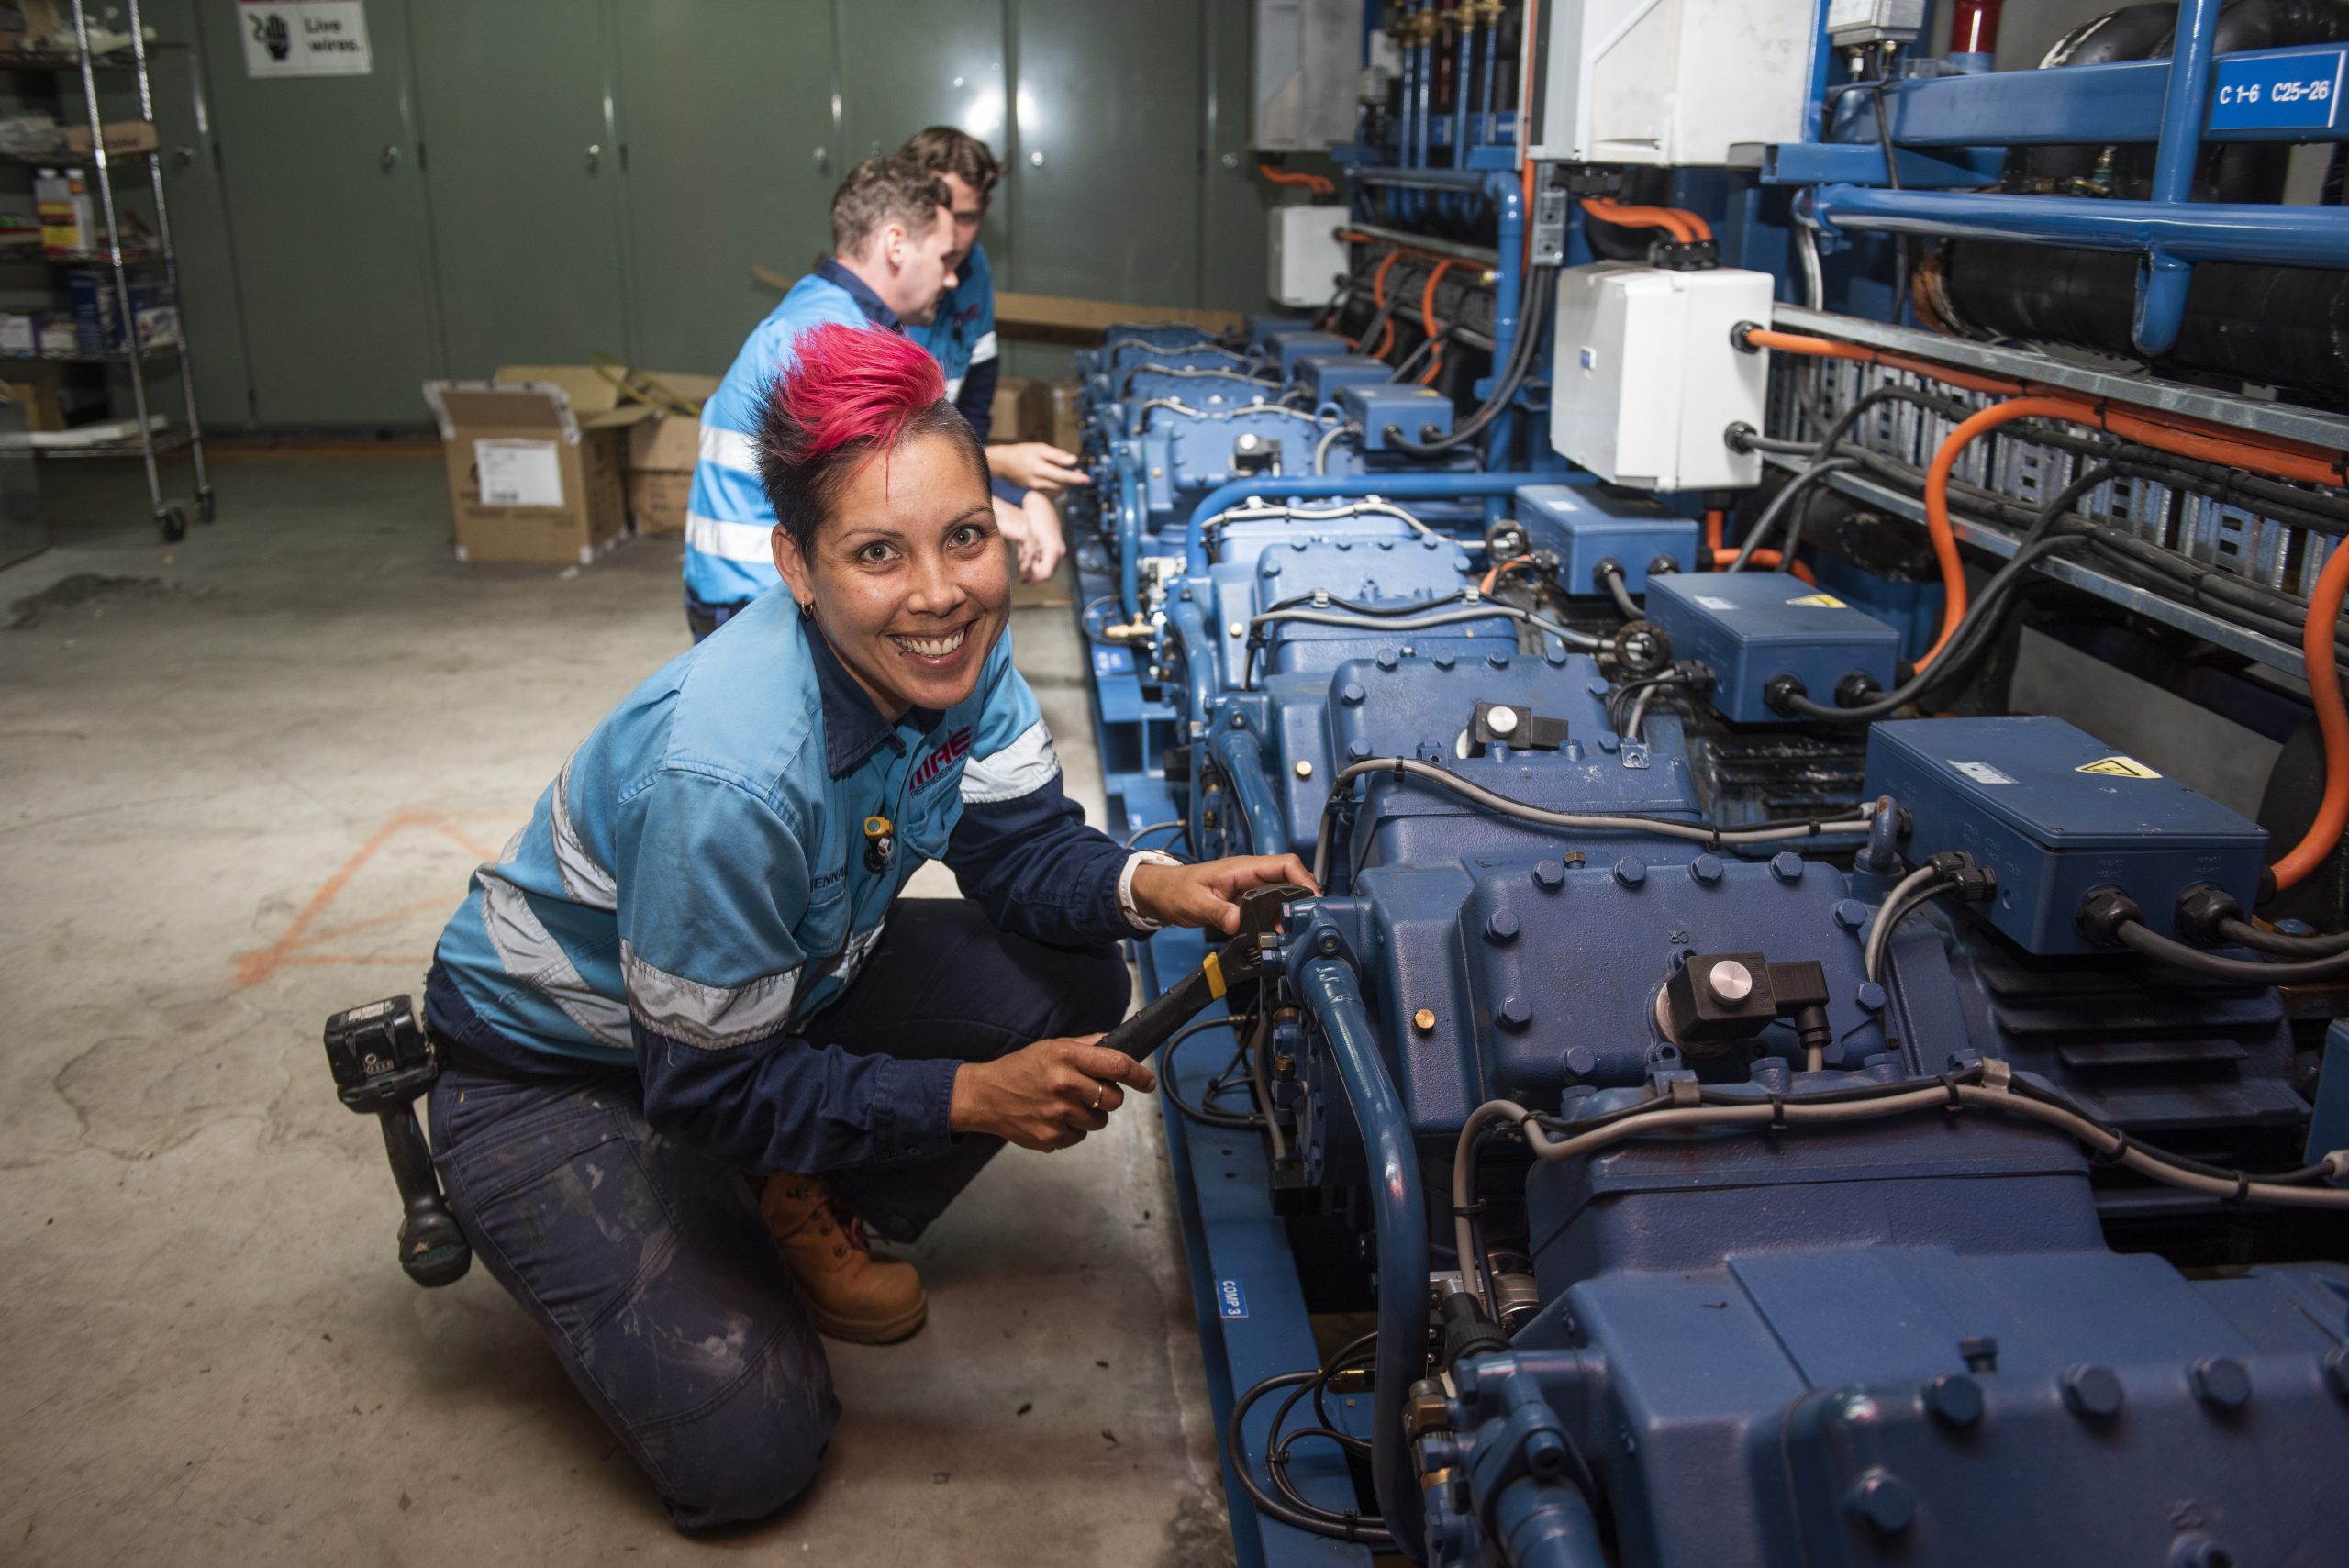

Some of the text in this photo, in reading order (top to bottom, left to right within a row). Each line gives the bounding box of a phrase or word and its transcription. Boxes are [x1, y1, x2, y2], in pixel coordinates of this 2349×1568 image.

[304, 17, 342, 33] Live
[2220, 80, 2331, 104] C 1-6 C25-26
[1222, 1280, 1240, 1307] COMP
